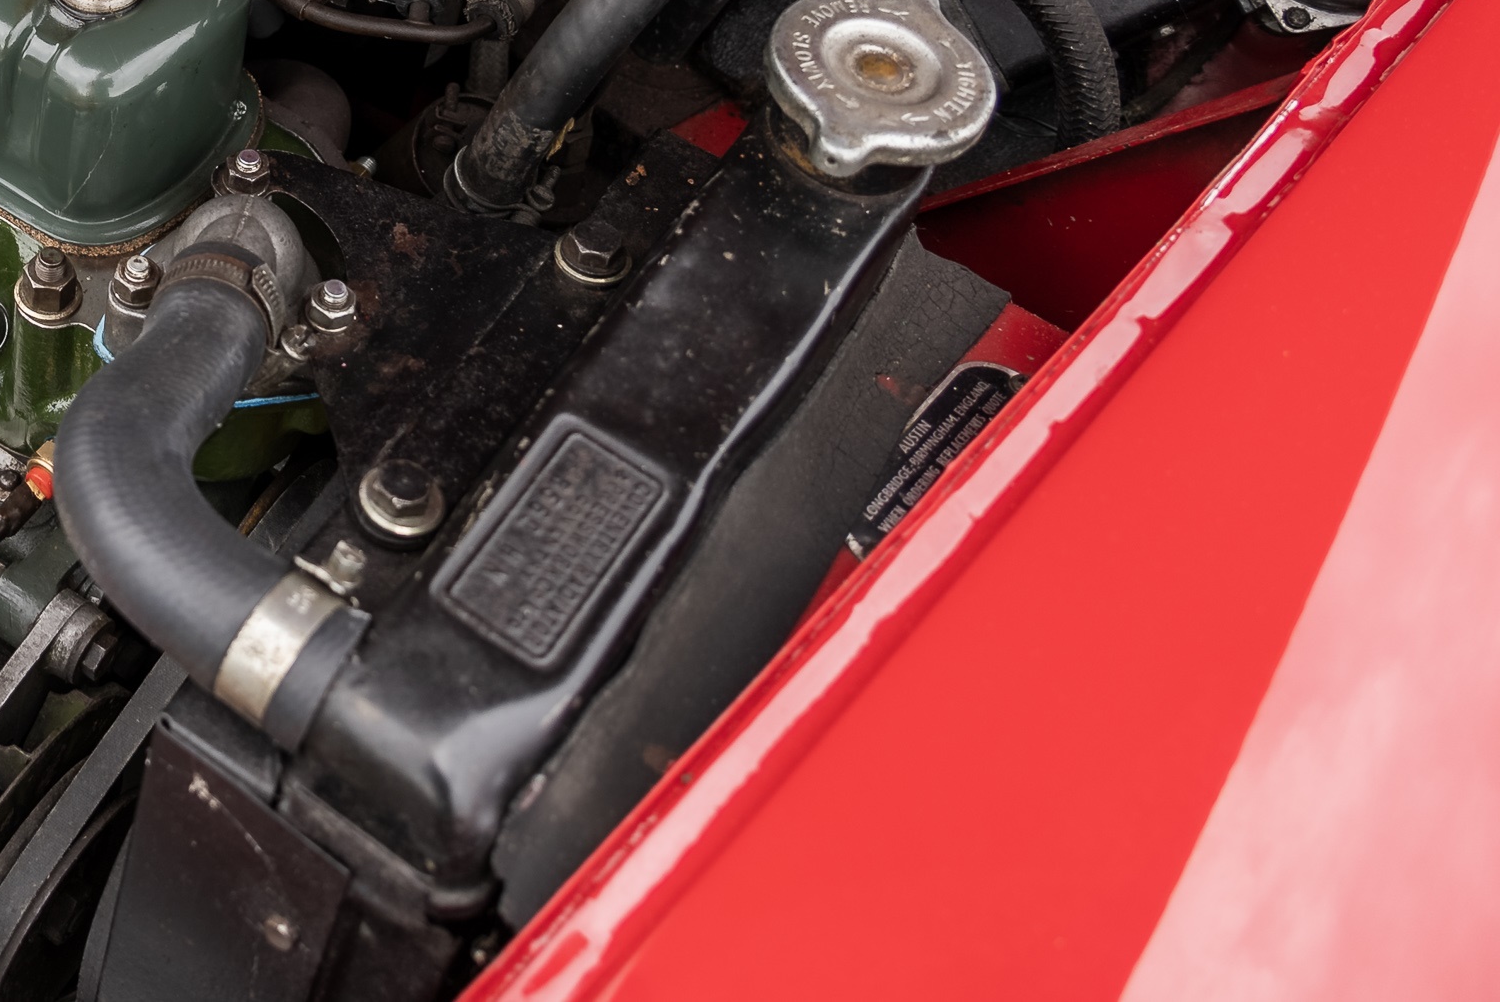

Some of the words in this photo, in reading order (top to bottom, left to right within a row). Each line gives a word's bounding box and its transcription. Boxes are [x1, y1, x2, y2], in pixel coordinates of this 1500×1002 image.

[801, 0, 871, 28] REMOVE
[792, 31, 835, 91] SLOWLY
[933, 61, 977, 124] TIGHTEN
[877, 505, 907, 533] WHEN
[902, 465, 941, 507] ORDERING
[936, 414, 986, 468] REPLACEMENTS
[982, 390, 1008, 416] QUOTE
[898, 419, 932, 454] AUSTIN
